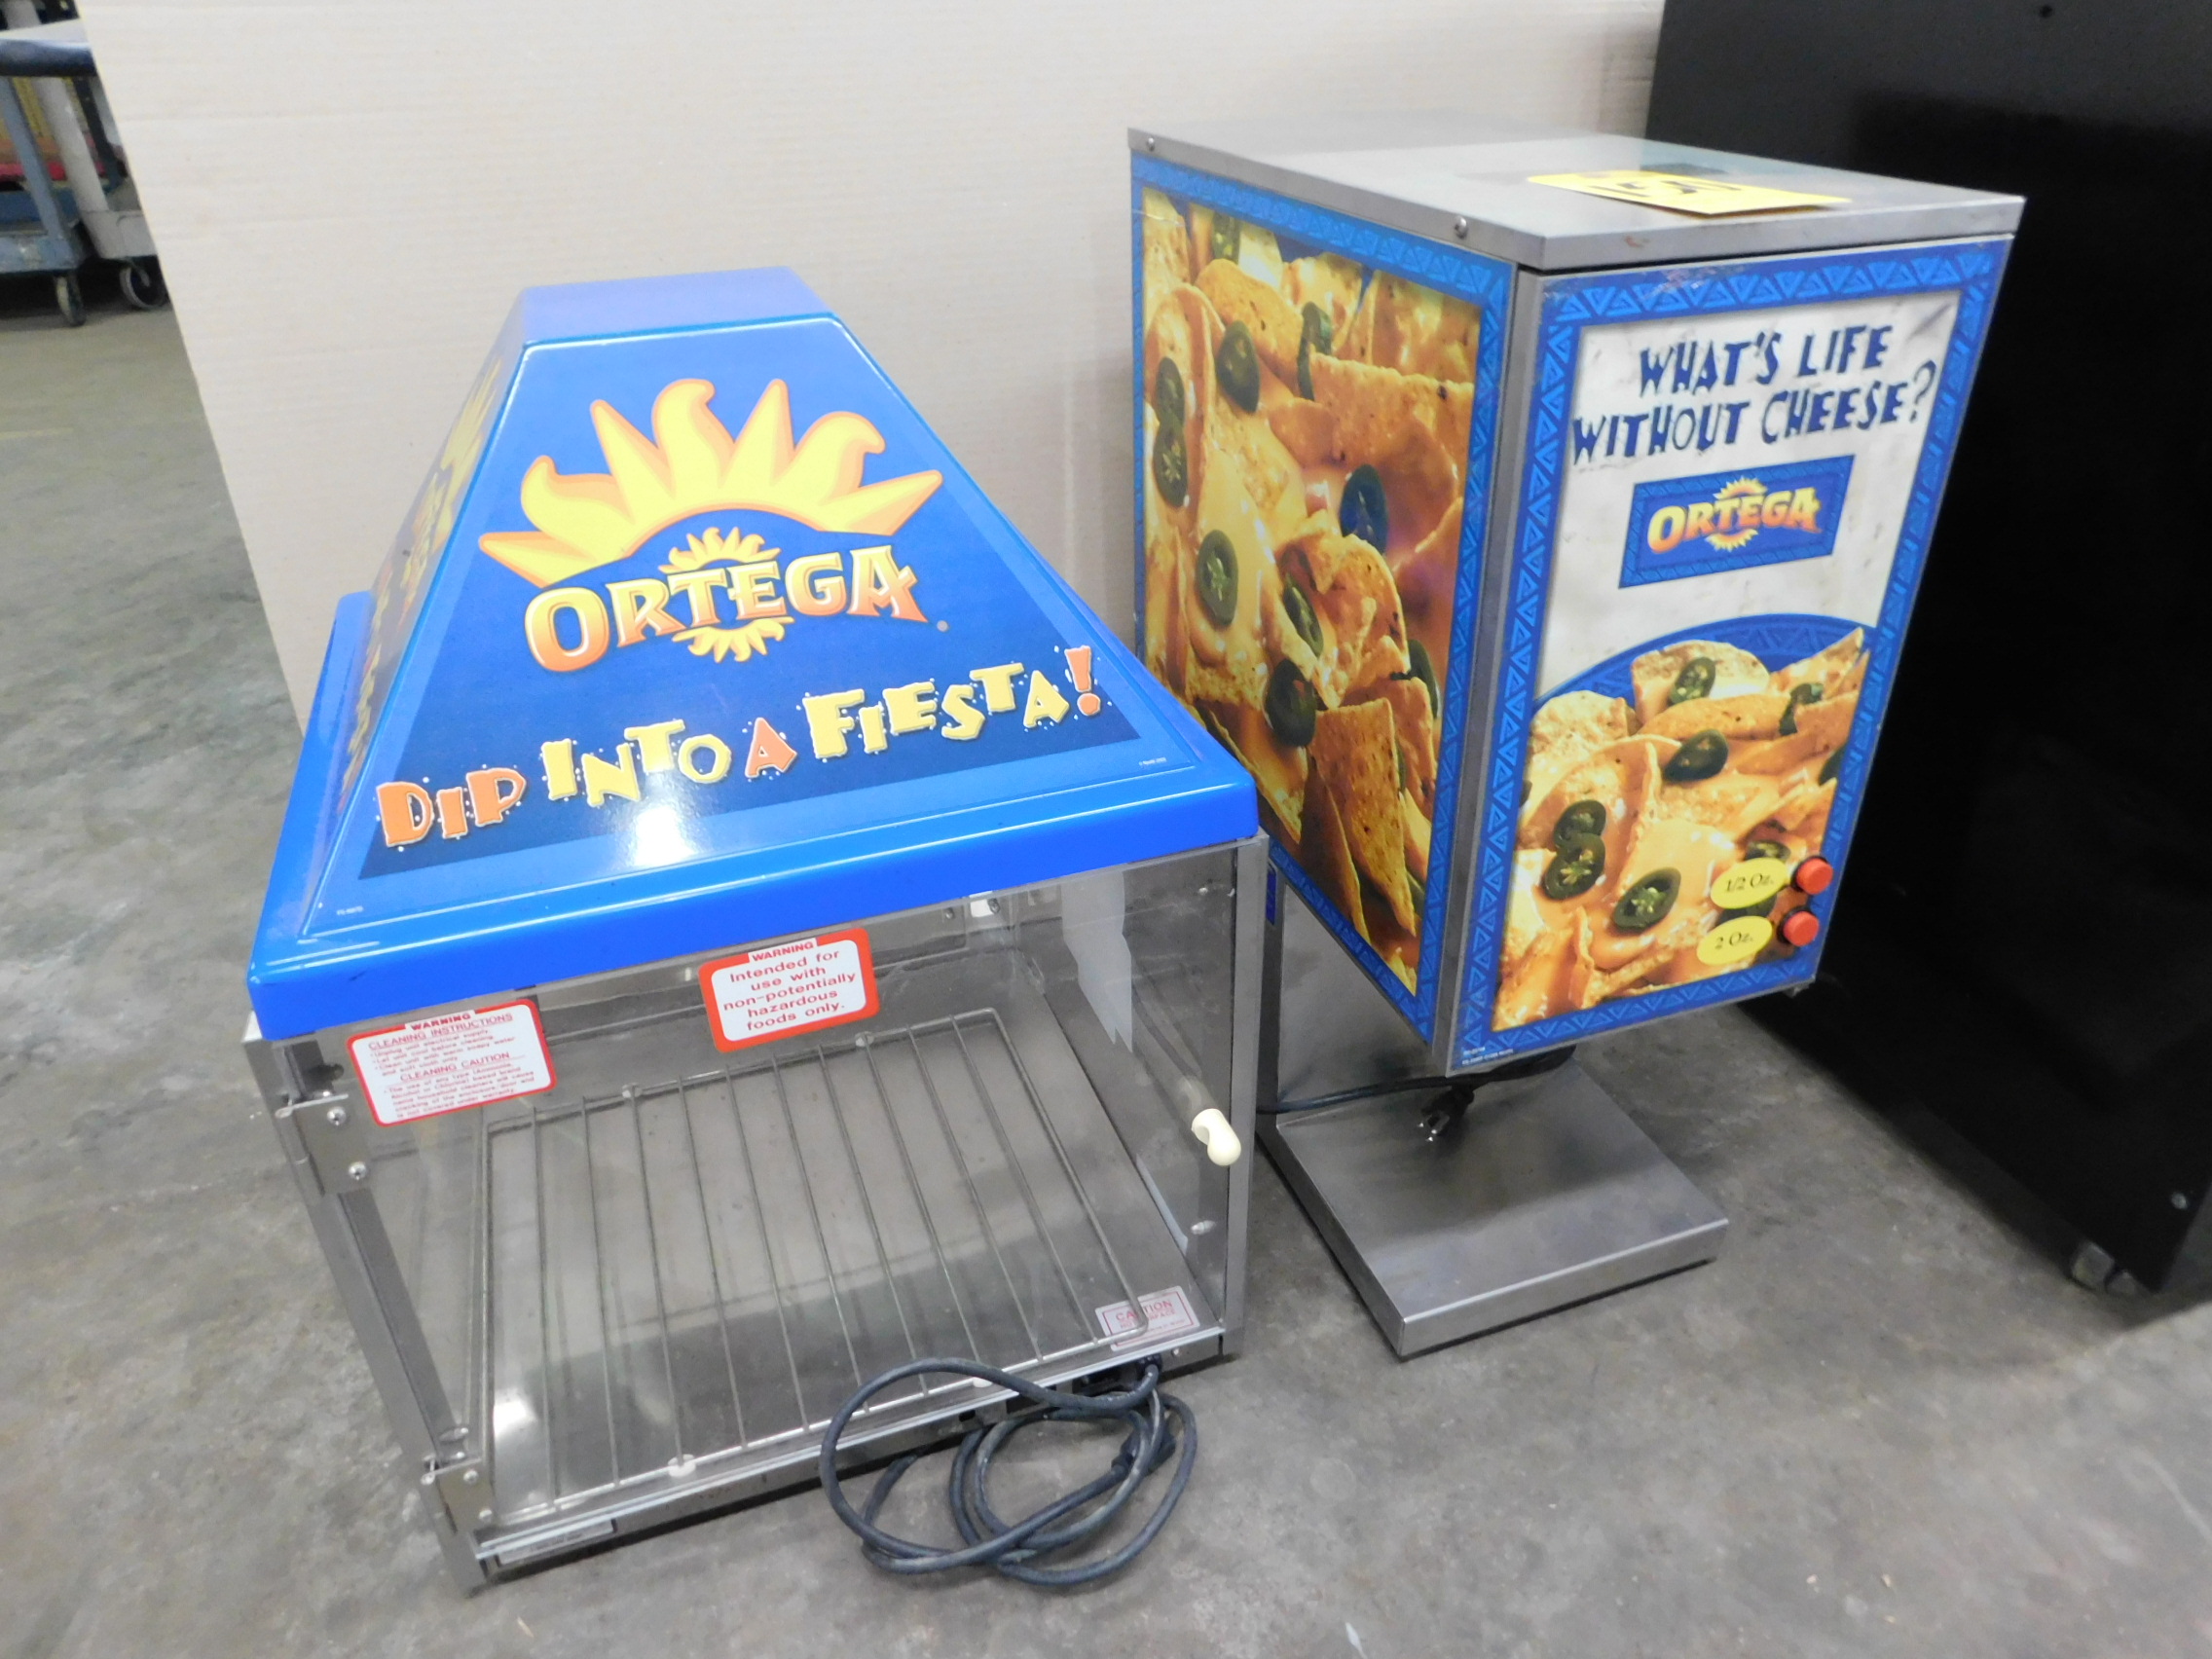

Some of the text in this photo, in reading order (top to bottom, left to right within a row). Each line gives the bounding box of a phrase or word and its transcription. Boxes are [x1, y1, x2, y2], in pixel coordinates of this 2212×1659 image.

[1639, 324, 1894, 397] WHAT'S LIFE
[1571, 358, 1937, 465] WITHOUT CHEESE?
[1646, 487, 1823, 554] ORTEGA
[524, 545, 929, 672] ORTEGA
[376, 645, 1102, 848] DIP INTO A FIESTA!
[1726, 876, 1746, 892] 1/2
[752, 941, 815, 962] WARNING
[1714, 937, 1724, 949] 2
[730, 950, 840, 983] Intended for
[751, 967, 827, 991] use with
[723, 973, 856, 1011] non-potentially
[747, 989, 838, 1017] hazardous
[368, 1013, 513, 1050] CLEANING INSTRUCTIONS
[411, 1013, 471, 1031] WARNING
[747, 1002, 845, 1031] foods only.
[400, 1051, 510, 1082] CLEANING CAUTION
[1116, 1300, 1173, 1321] CATION
